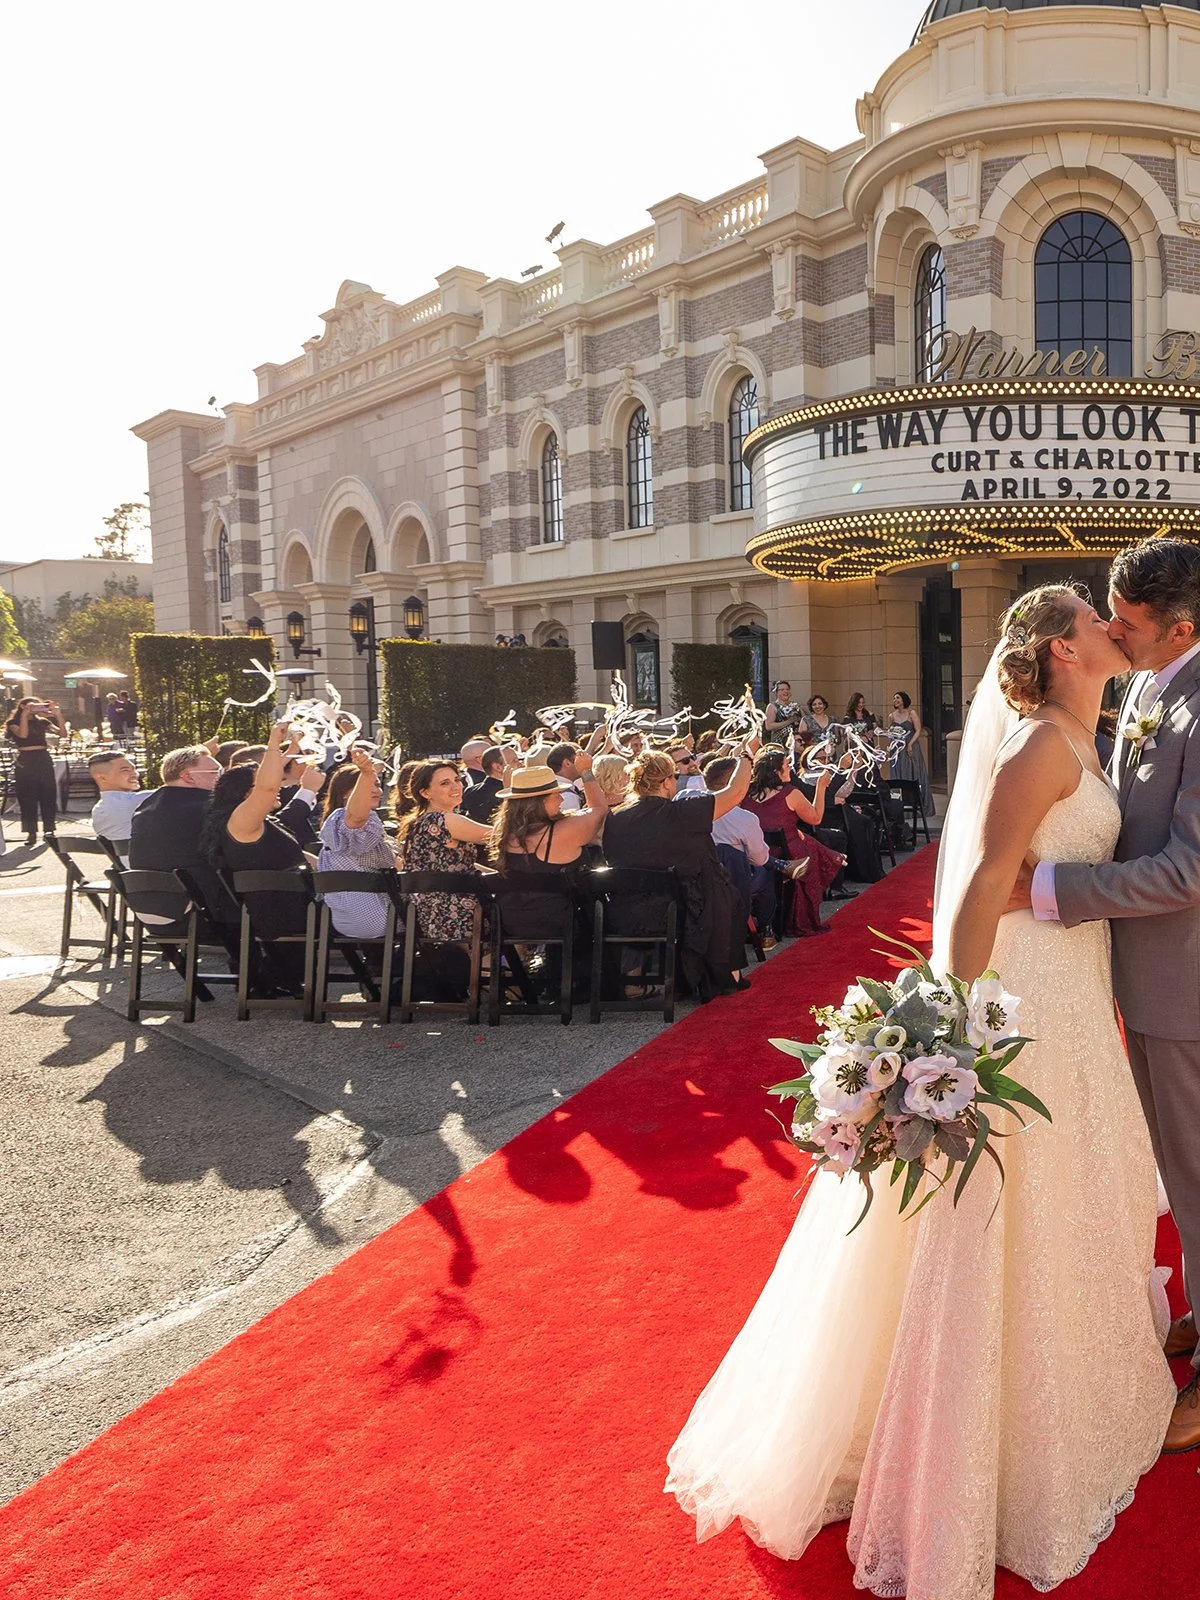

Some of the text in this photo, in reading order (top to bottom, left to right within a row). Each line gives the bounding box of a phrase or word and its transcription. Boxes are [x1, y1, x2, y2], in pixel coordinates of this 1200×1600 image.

[925, 325, 1107, 382] Warner
[814, 417, 868, 460] THE
[876, 408, 949, 450] WAY
[963, 404, 1042, 442] YOU
[1056, 403, 1165, 443] LOOK
[931, 449, 1000, 473] CURT
[1009, 450, 1024, 469] &
[961, 477, 1172, 501] APRIL 9, 2022
